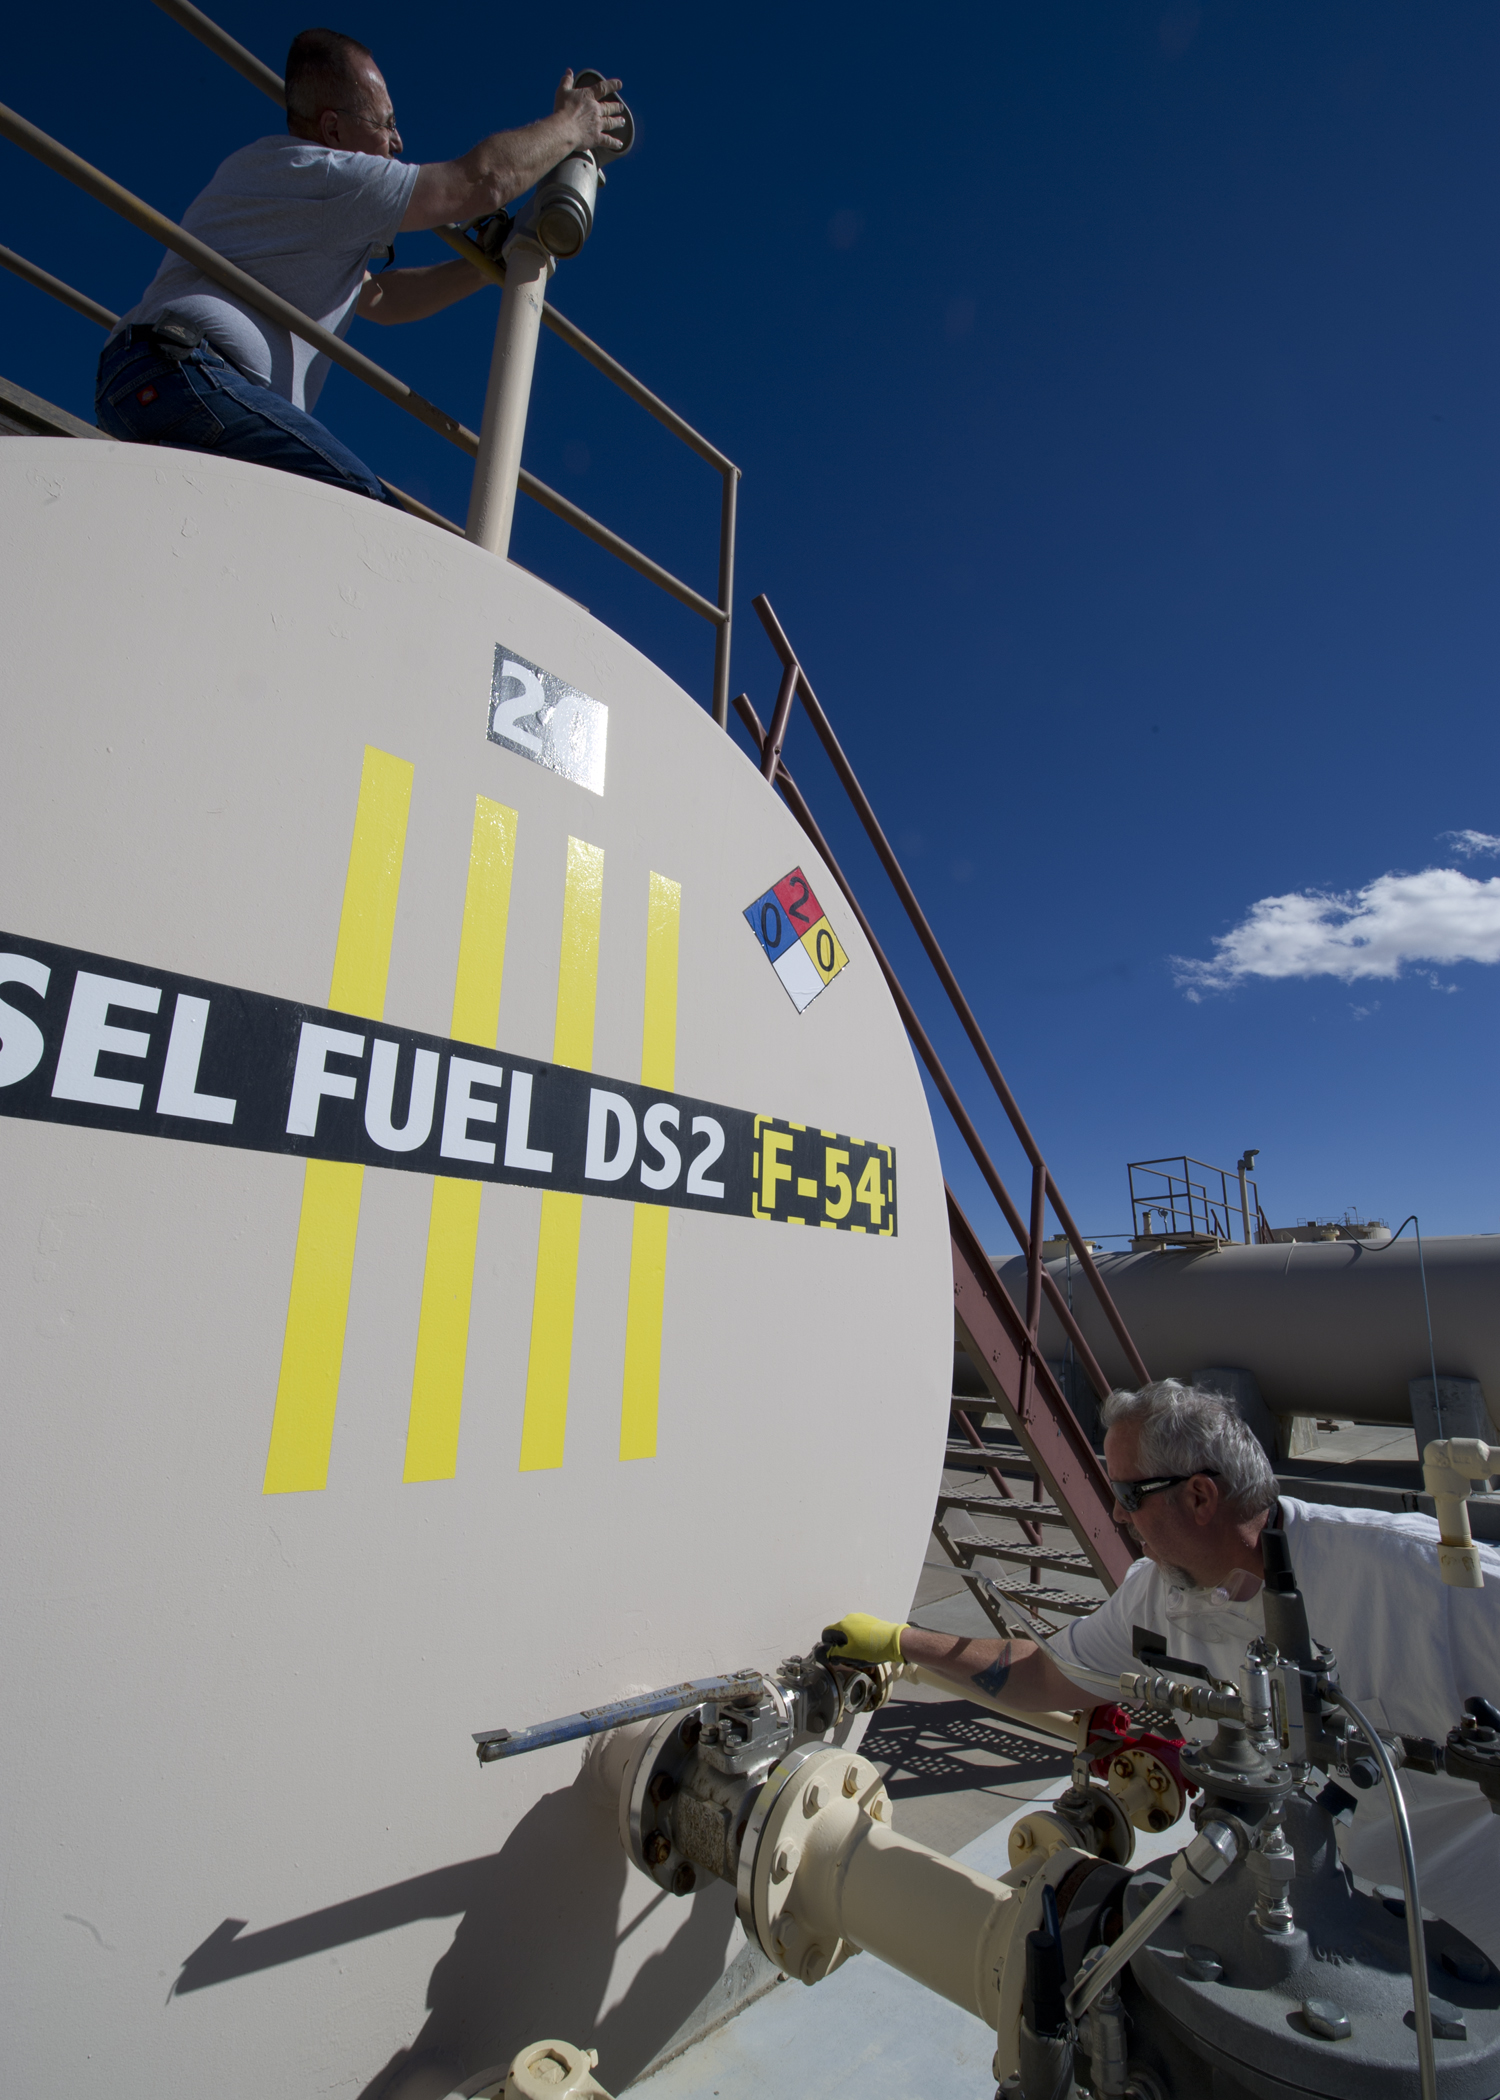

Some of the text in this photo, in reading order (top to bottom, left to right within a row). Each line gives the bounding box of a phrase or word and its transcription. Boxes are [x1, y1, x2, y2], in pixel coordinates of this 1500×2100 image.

[788, 876, 810, 924] 2
[761, 902, 782, 949] 0
[816, 929, 835, 972] 0
[286, 1022, 553, 1172] FUEL
[585, 1088, 726, 1199] DS2
[762, 1130, 886, 1225] F-54
